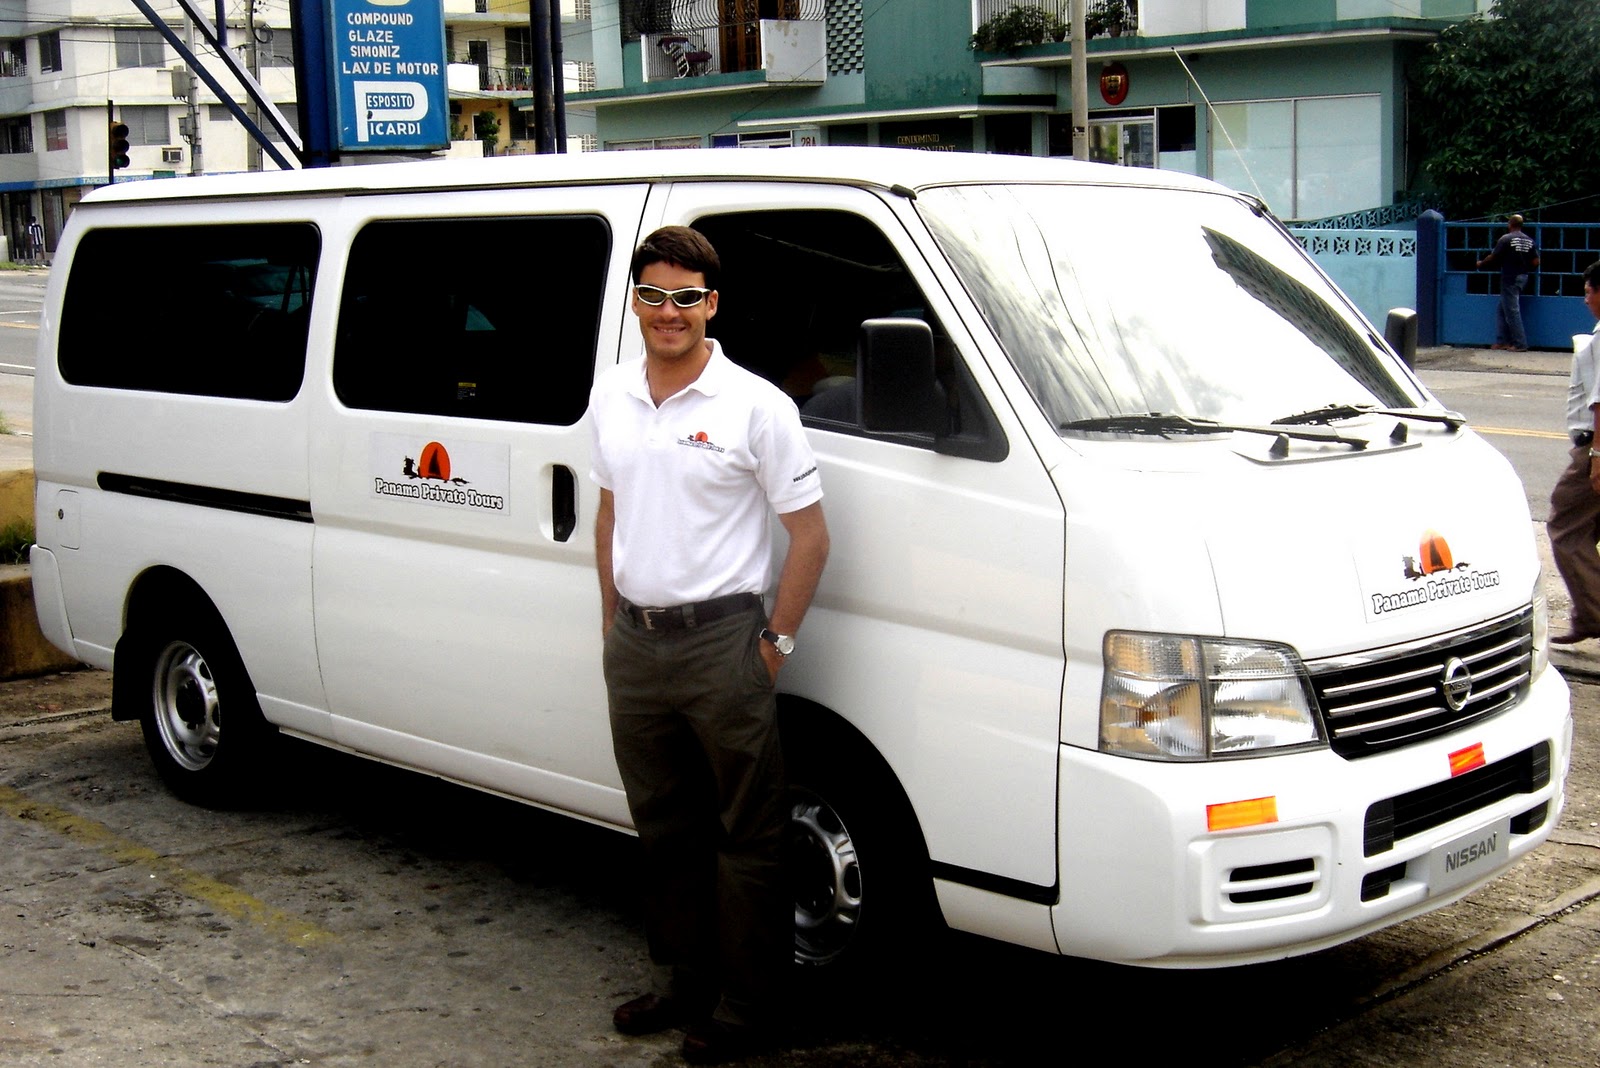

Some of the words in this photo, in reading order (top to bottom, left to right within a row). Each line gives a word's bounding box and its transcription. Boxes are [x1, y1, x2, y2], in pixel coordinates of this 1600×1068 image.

[347, 13, 413, 25] COMPOUND
[349, 30, 393, 43] GLAZE
[350, 45, 400, 58] SIMONIZ
[342, 62, 371, 74] LAV.
[375, 62, 391, 74] DE
[397, 63, 439, 75] MOTOR
[367, 95, 413, 107] ESPOSITO
[375, 478, 419, 498] Panama
[420, 483, 466, 504] Private
[467, 489, 503, 509] Tours
[1372, 588, 1428, 614] Panama
[1427, 577, 1471, 601] Private
[1471, 570, 1499, 590] Tours
[1446, 836, 1496, 872] NISSAN
